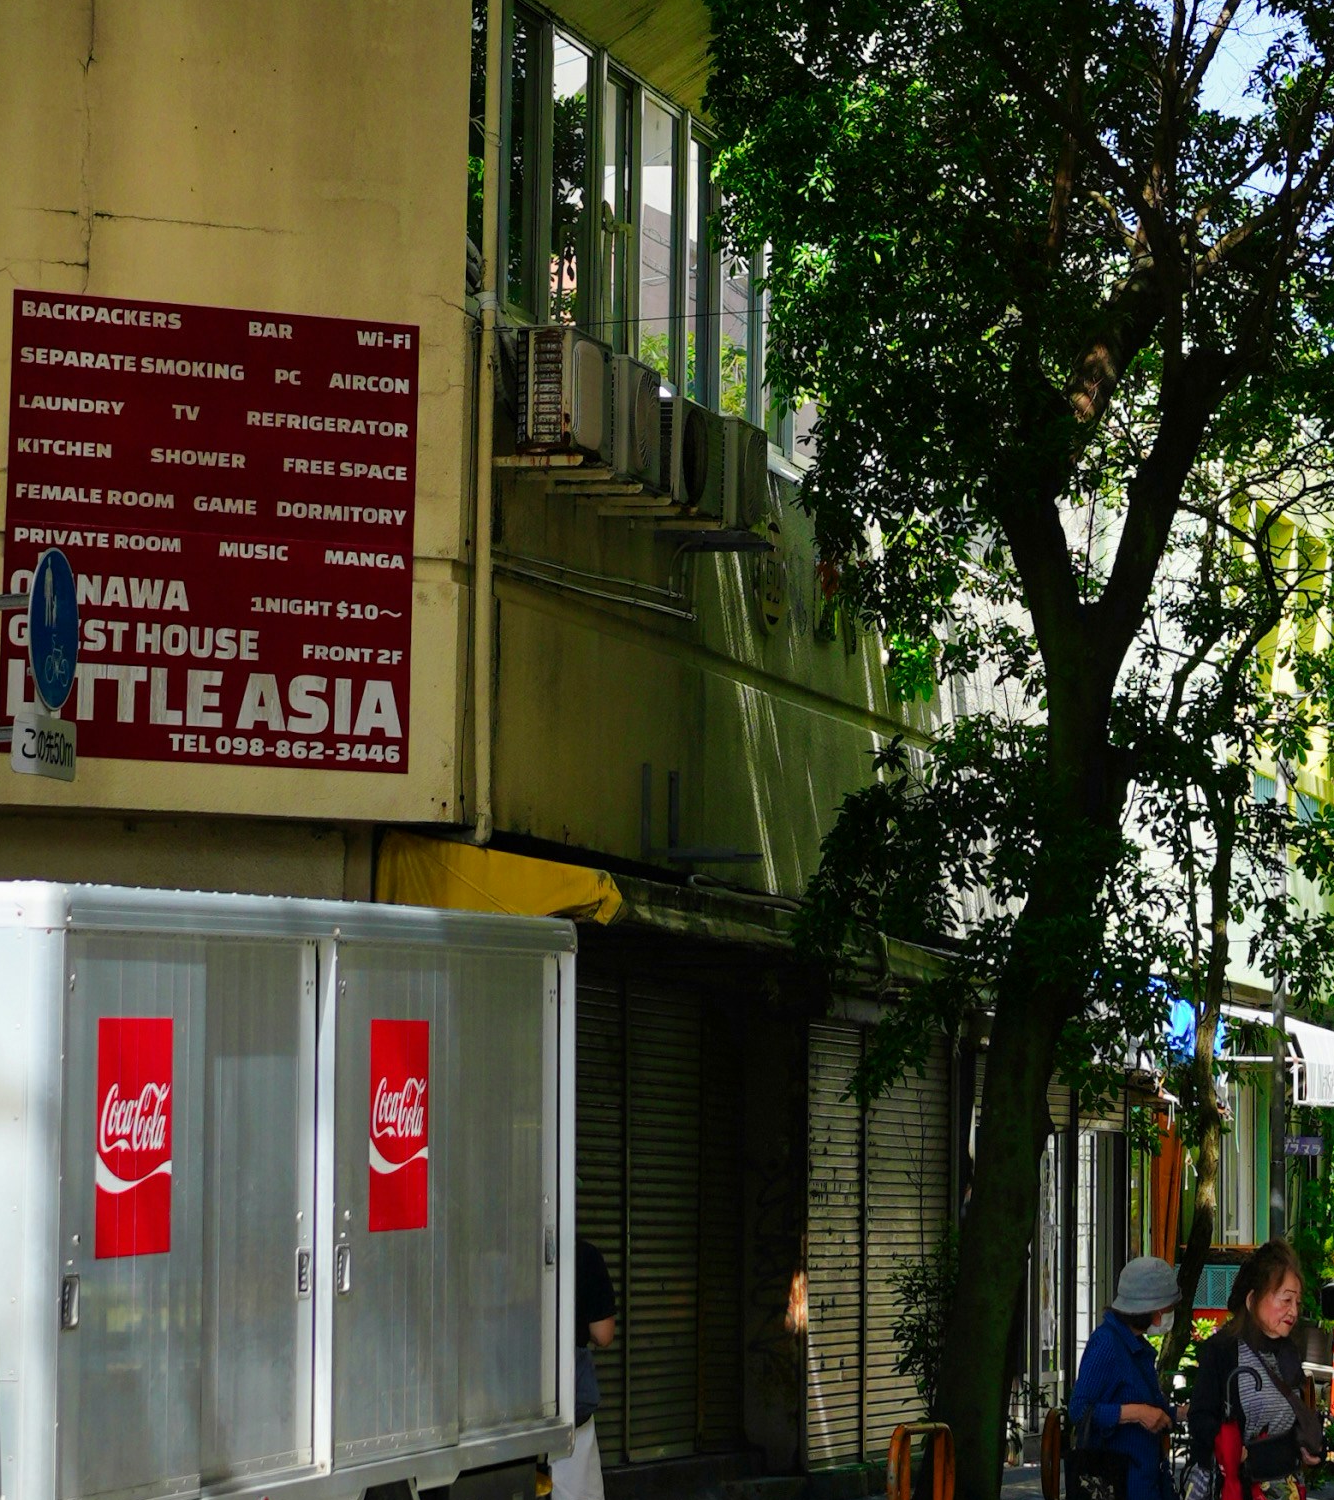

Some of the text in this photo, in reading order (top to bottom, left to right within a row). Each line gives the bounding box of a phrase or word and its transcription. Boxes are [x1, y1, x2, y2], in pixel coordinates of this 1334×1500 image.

[21, 300, 412, 349] BACKPACKERS BAR Wi-Fi
[20, 346, 411, 395] SEPARATE SMOKING PC AIRCON
[18, 394, 409, 438] LAUNDRY TV REFRIGERATOR
[17, 438, 408, 482] KITCHEN SHOWER FREE SPACE
[15, 483, 407, 526] FEMALE ROOM GAME DORMITORY
[14, 527, 406, 570] PRIVATE ROOM MUSIC MANGA
[10, 569, 190, 612] ONAWA
[250, 596, 331, 617] 1NIGHT
[8, 614, 260, 661] GST HOUSE
[302, 643, 404, 665] FRONT 2F
[6, 658, 224, 728] LTTLE
[236, 673, 403, 738] ASIA
[168, 733, 401, 764] TEL 098-862-3446
